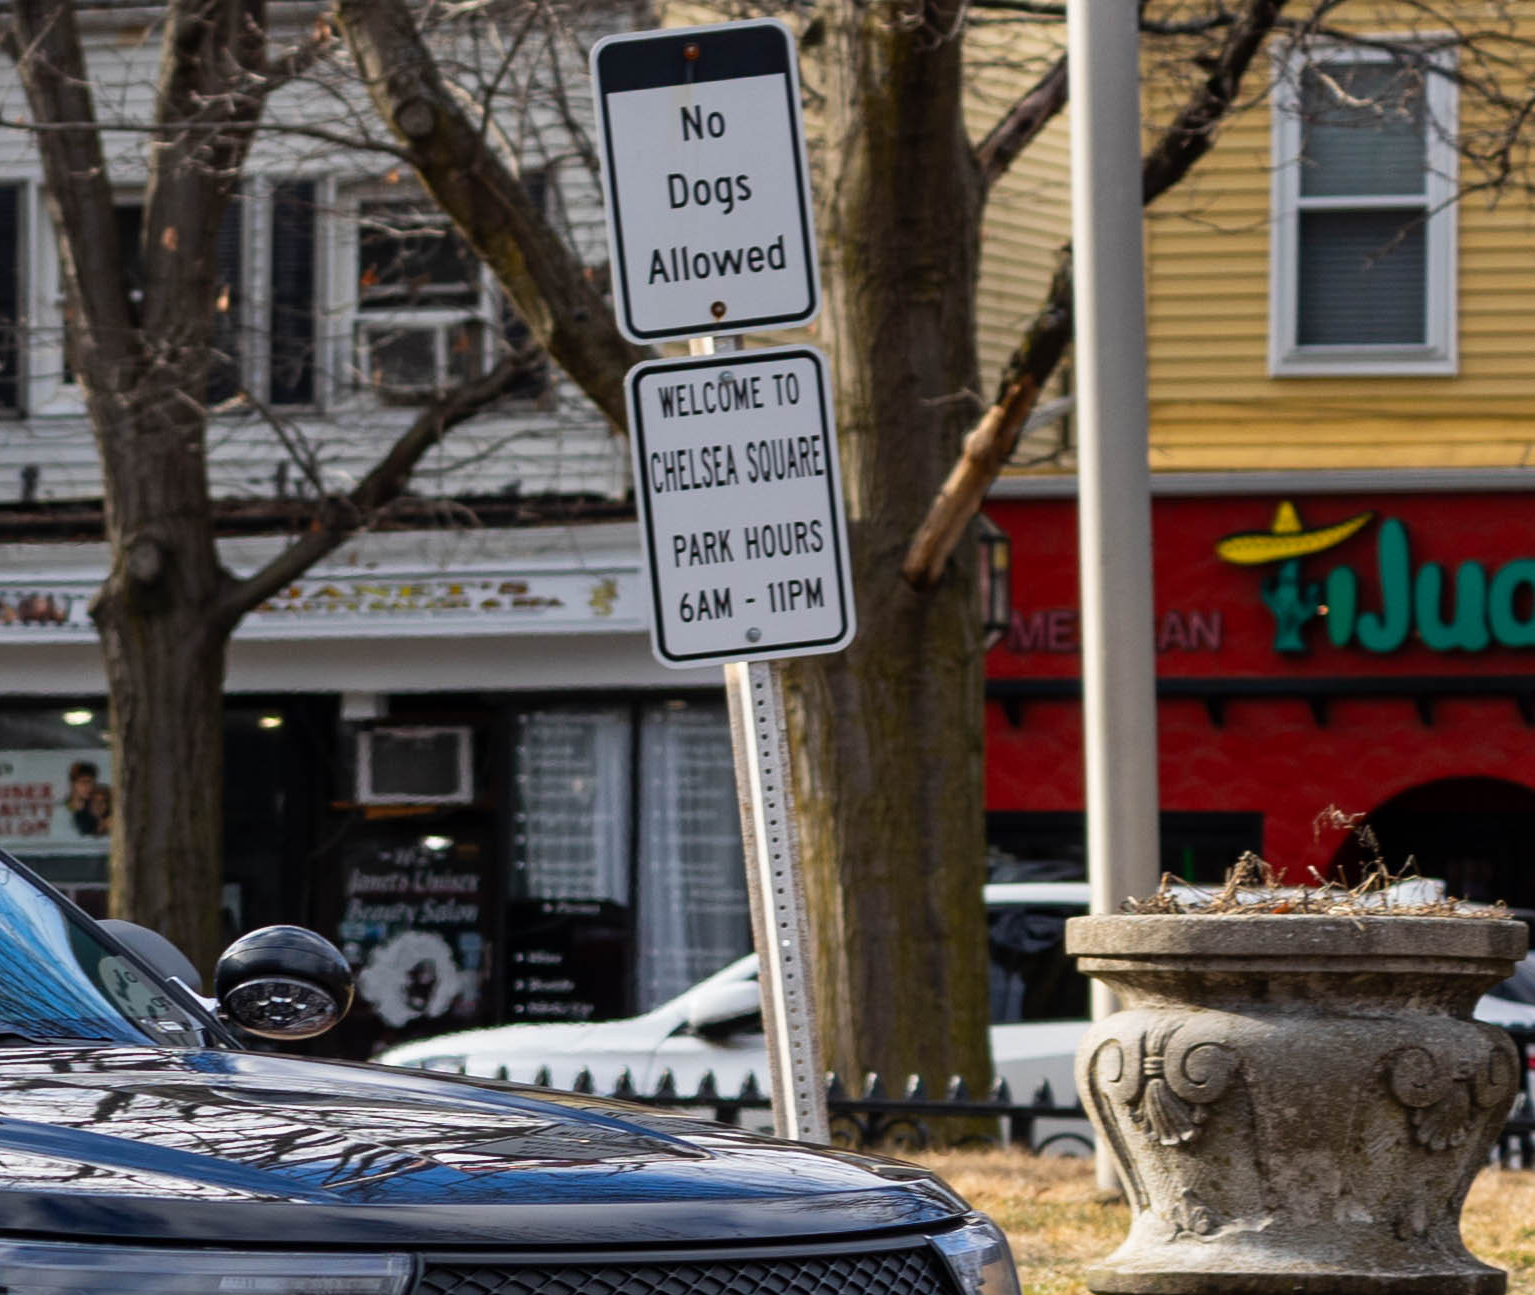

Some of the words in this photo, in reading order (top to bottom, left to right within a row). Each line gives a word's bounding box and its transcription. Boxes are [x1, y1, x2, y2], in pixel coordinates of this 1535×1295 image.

[680, 105, 726, 141] No
[668, 173, 752, 215] Dogs
[648, 234, 787, 285] Allowed
[658, 376, 764, 418] WELCOME
[772, 373, 799, 406] TO
[650, 444, 739, 493] CHELSEA
[747, 435, 824, 483] SQUARE
[673, 529, 734, 568] PARK
[745, 520, 824, 560] HOURS
[680, 587, 733, 623] 6AM
[767, 577, 824, 613] 11PM
